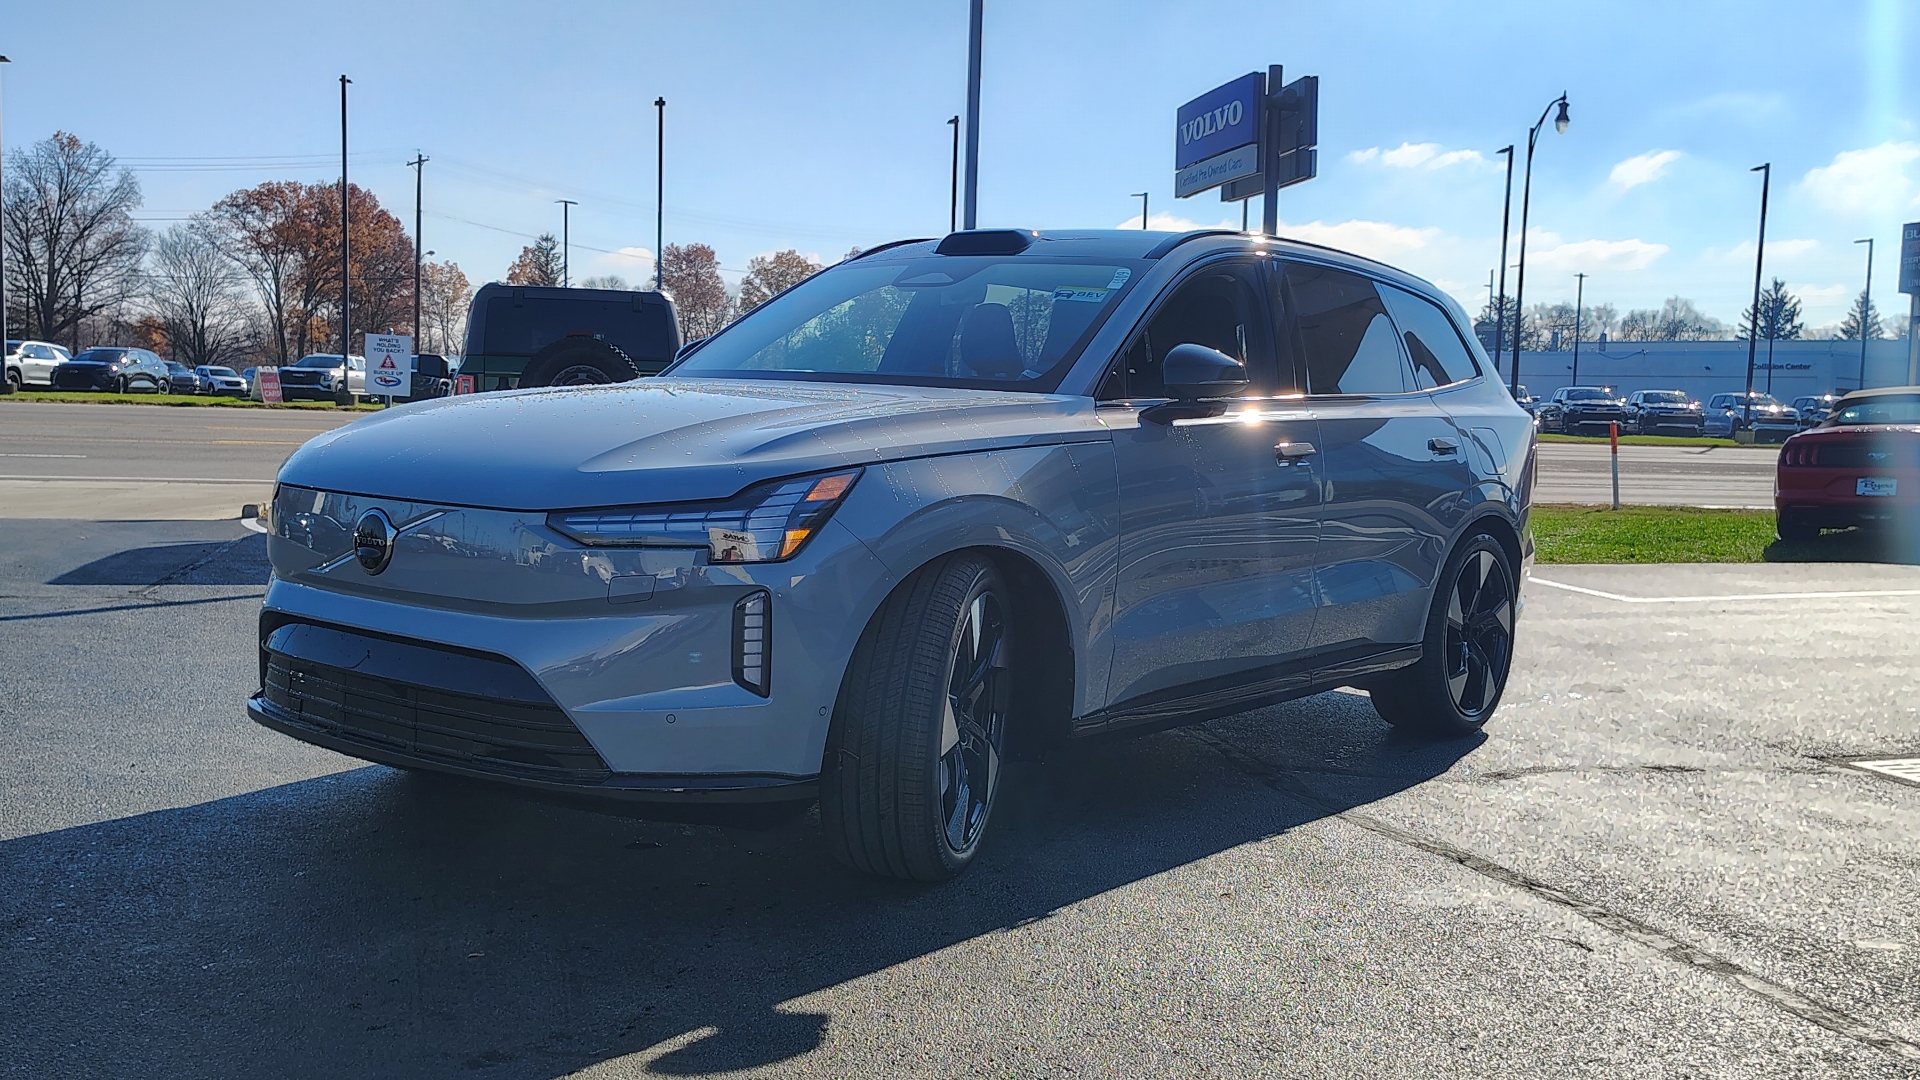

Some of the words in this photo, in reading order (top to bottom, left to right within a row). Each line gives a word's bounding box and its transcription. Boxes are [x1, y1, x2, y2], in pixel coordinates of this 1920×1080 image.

[1181, 100, 1243, 146] VOLVO
[1180, 170, 1197, 188] Certified
[1208, 161, 1227, 179] Owned
[1228, 157, 1243, 172] Cars
[358, 537, 385, 546] VOLVO
